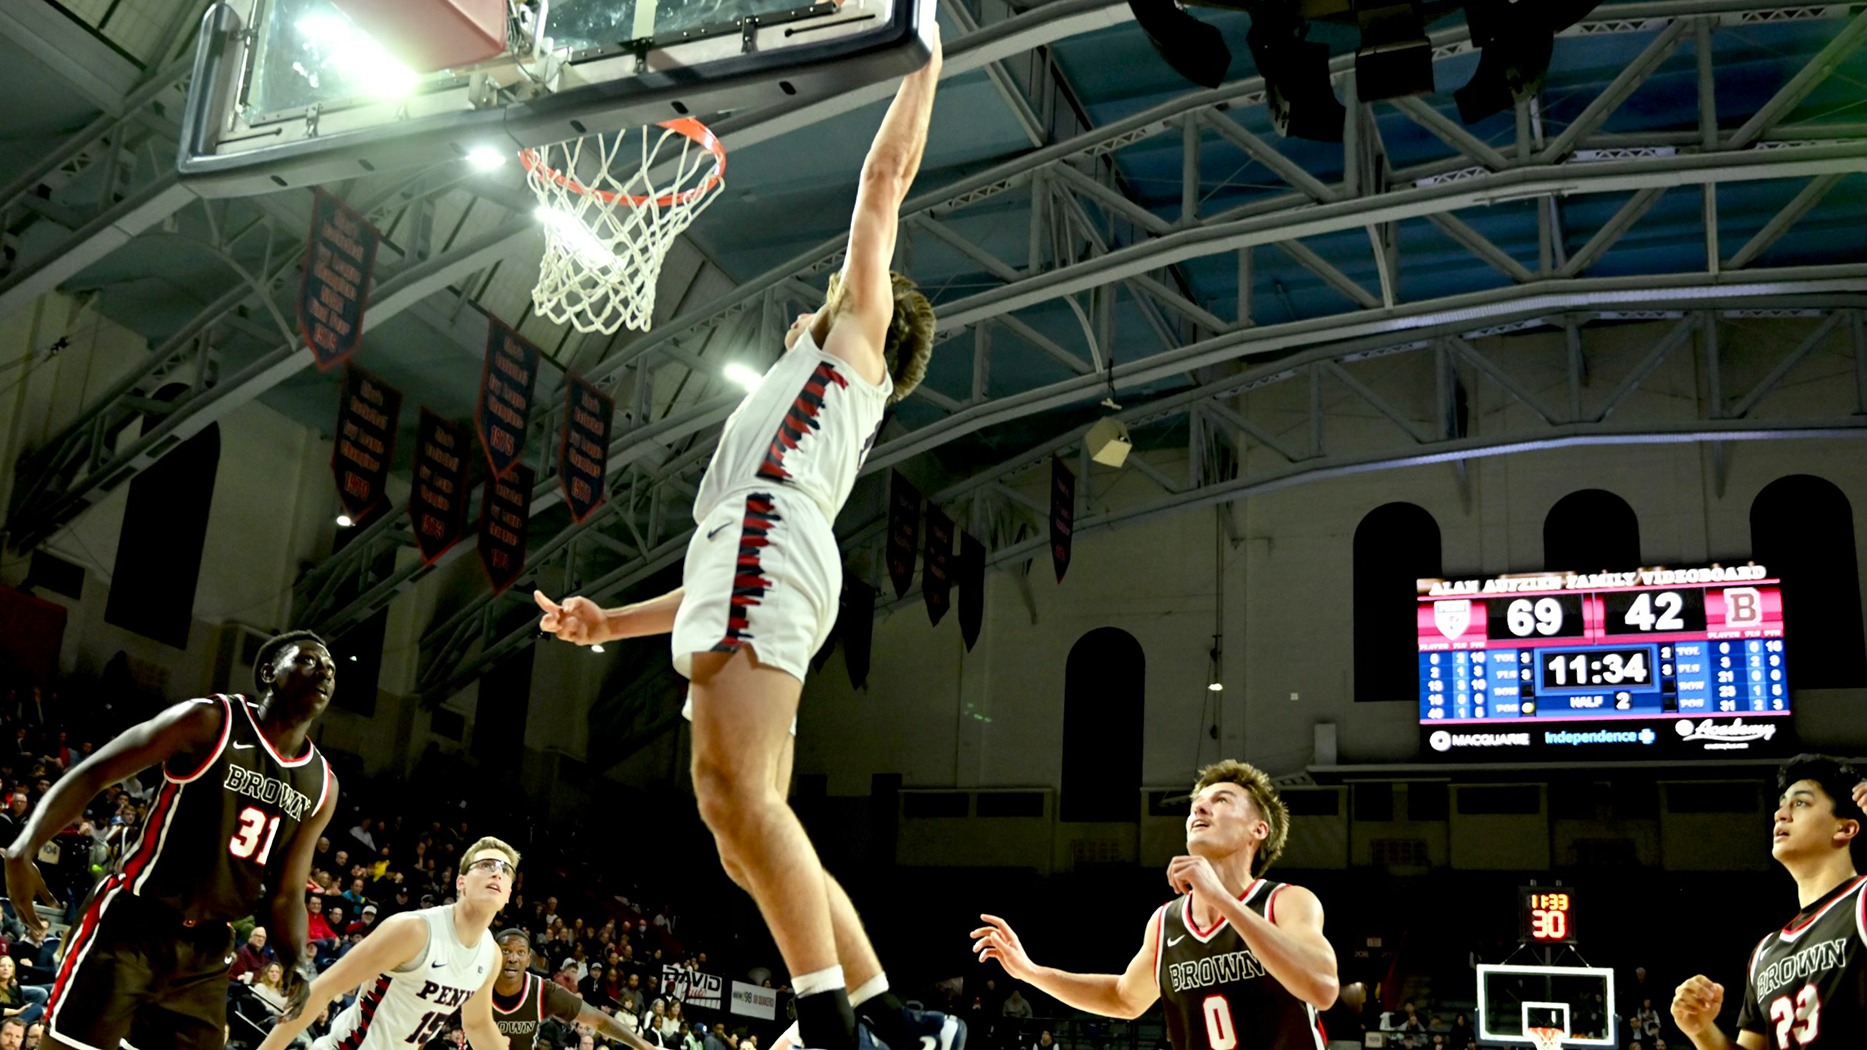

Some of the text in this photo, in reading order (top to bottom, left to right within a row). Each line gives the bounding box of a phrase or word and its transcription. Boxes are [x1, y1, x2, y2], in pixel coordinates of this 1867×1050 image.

[1429, 580, 1478, 595] ALAN
[1566, 572, 1638, 590] FAMILY
[1639, 566, 1767, 585] VIDEOBOARD
[1507, 598, 1563, 636] 69
[1624, 592, 1684, 630] 42
[1726, 590, 1760, 625] B
[1661, 647, 1671, 658] 2
[1430, 667, 1440, 678] 2
[1457, 666, 1464, 677] 1
[1548, 653, 1647, 685] 11:34
[1718, 670, 1733, 682] 21
[1570, 692, 1630, 710] HALF 2
[1753, 685, 1761, 696] 1
[1458, 708, 1465, 719] 1
[1452, 733, 1530, 746] MACQUARIE
[1545, 729, 1637, 745] Independence
[1690, 718, 1776, 740] Academy
[224, 764, 311, 822] BROWN
[229, 807, 281, 866] 31
[1531, 894, 1569, 911] 11:33
[1532, 910, 1567, 938] 30
[664, 966, 721, 991] DAVID
[1169, 950, 1266, 992] BROWN
[1757, 938, 1847, 1004] BROWN
[405, 1011, 450, 1044] 15
[495, 1020, 536, 1035] OWN
[1203, 994, 1238, 1050] 0
[1770, 983, 1821, 1050] 23
